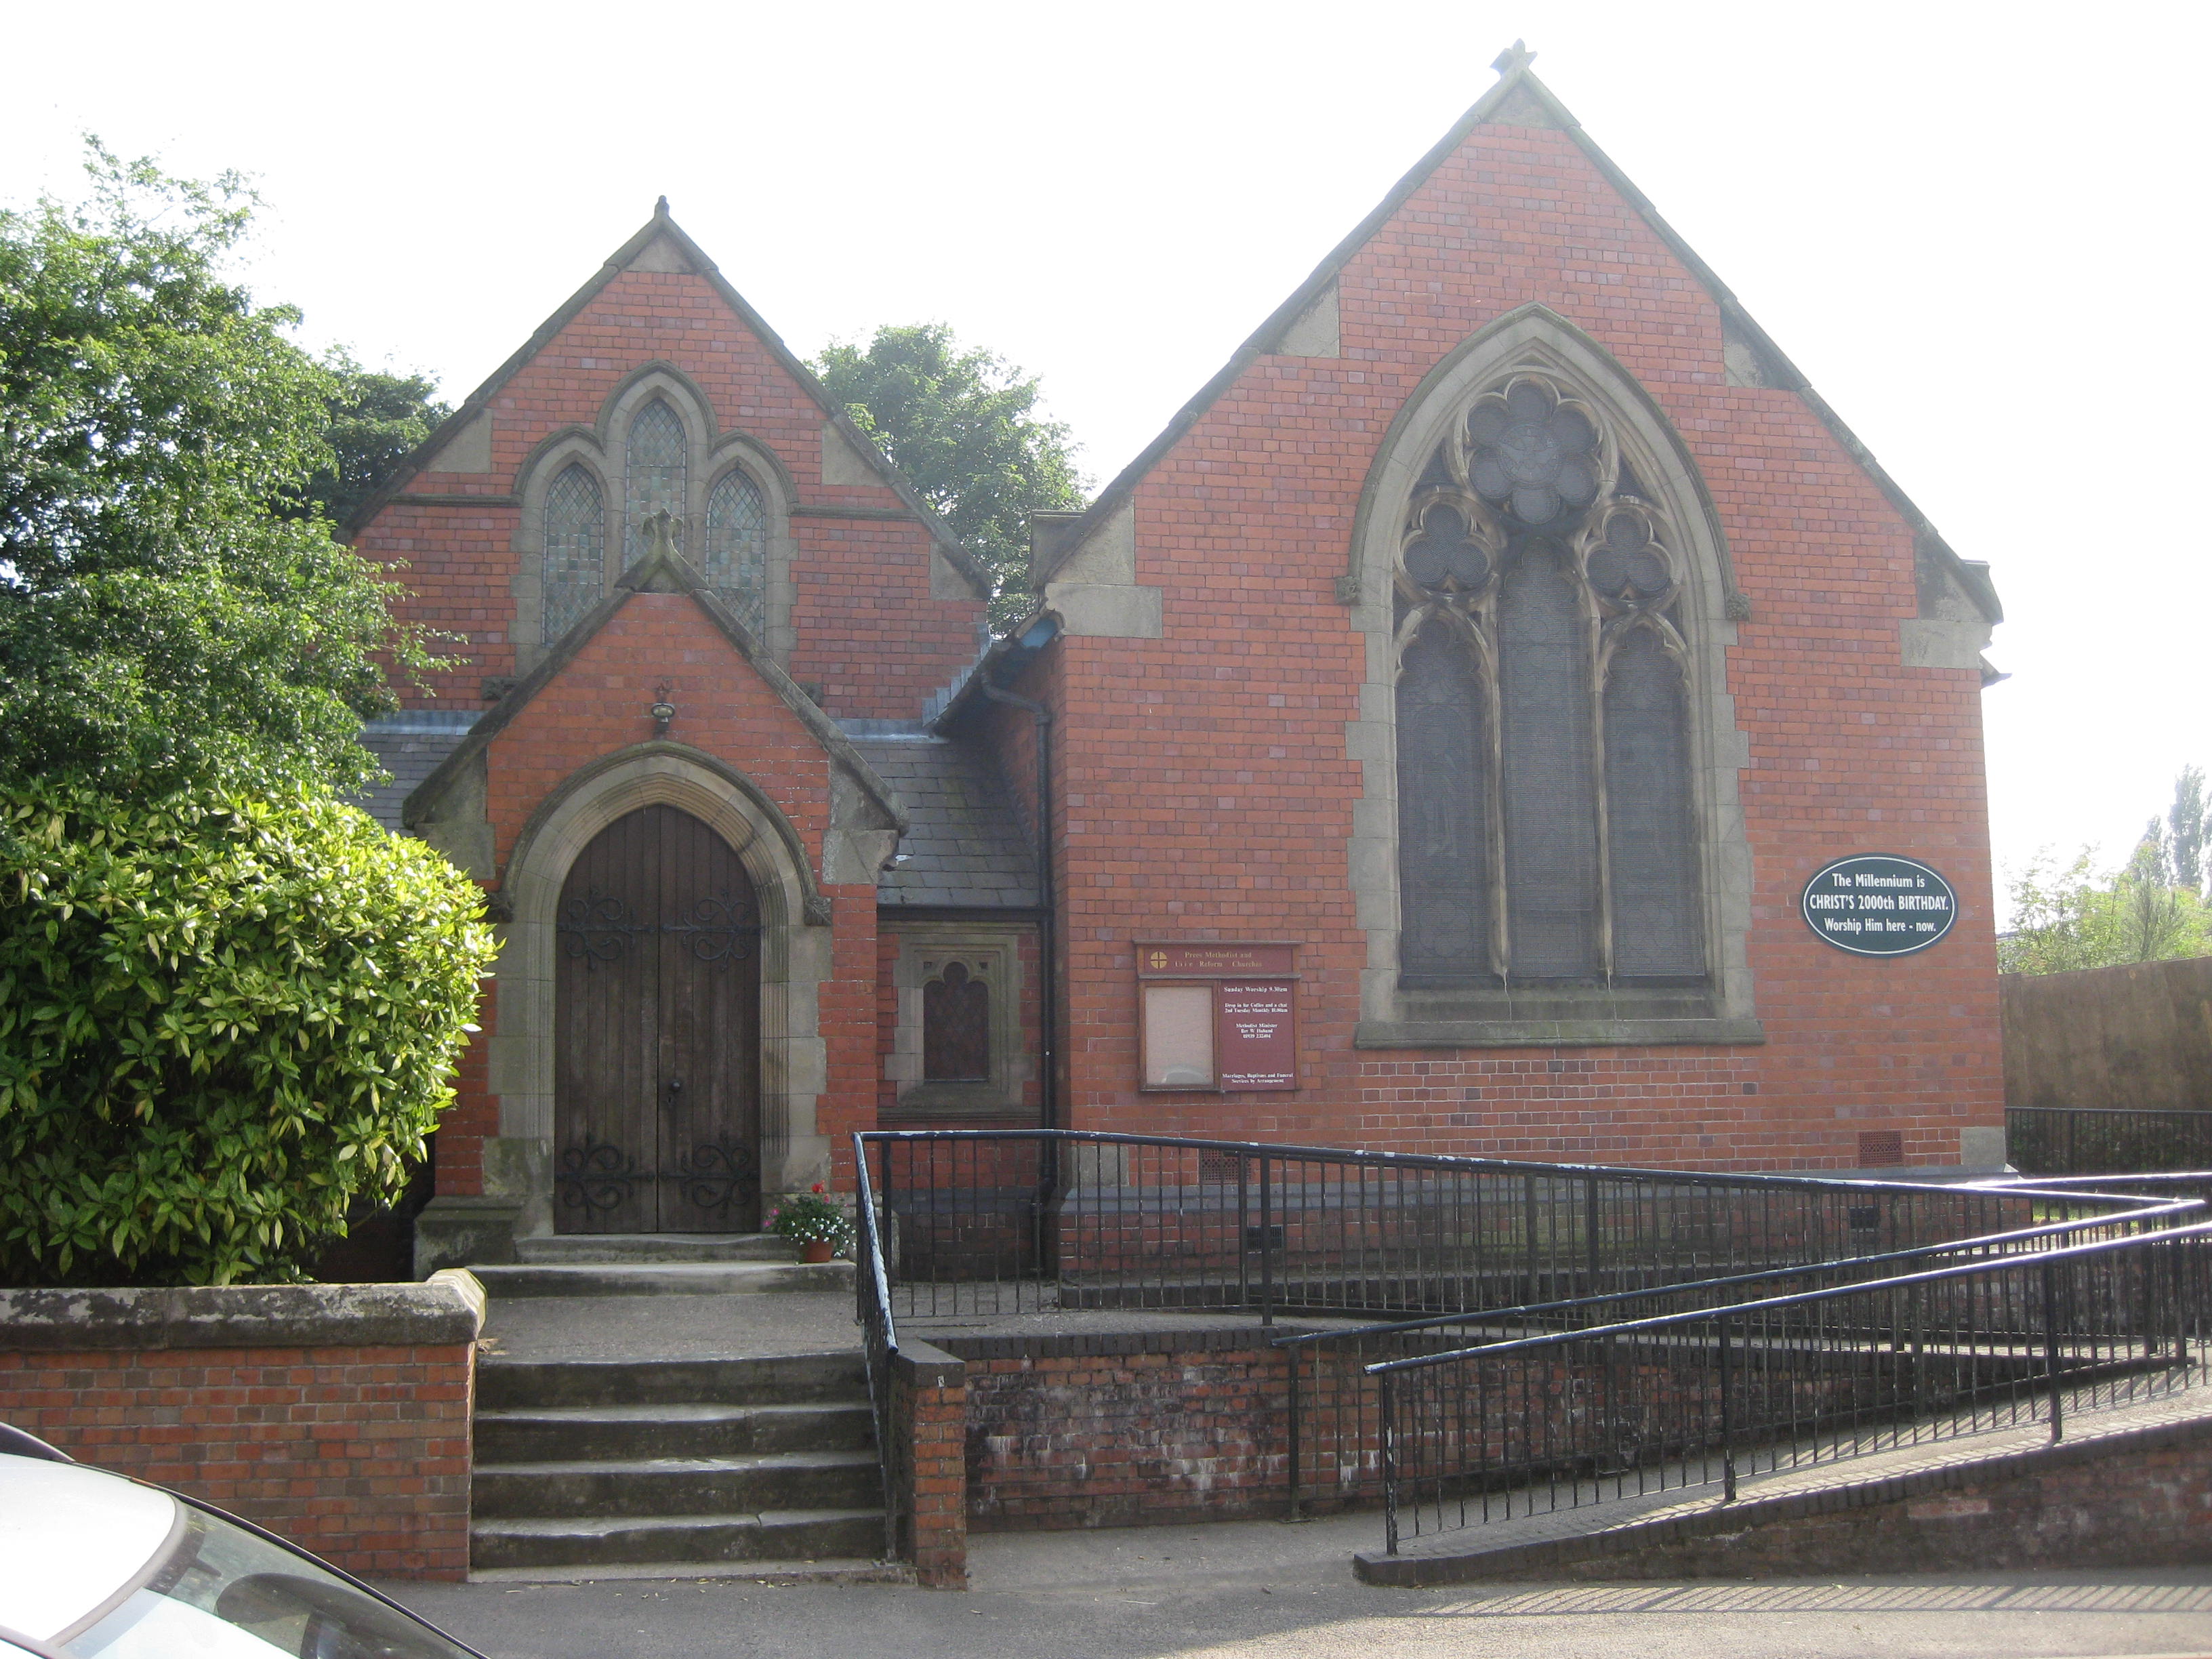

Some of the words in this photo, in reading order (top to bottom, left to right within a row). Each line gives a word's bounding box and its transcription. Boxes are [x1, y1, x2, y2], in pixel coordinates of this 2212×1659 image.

[1832, 873, 1851, 886] The
[1855, 874, 1912, 887] Millennium
[1917, 874, 1925, 887] is
[1809, 895, 1854, 909] CHRIST'S
[1858, 895, 1894, 909] 2000th
[1898, 896, 1948, 910] BIRTHDAY.
[1824, 918, 1862, 935] Worship
[1865, 918, 1883, 931] Him
[1886, 918, 1906, 931] here
[1916, 922, 1936, 932] now.
